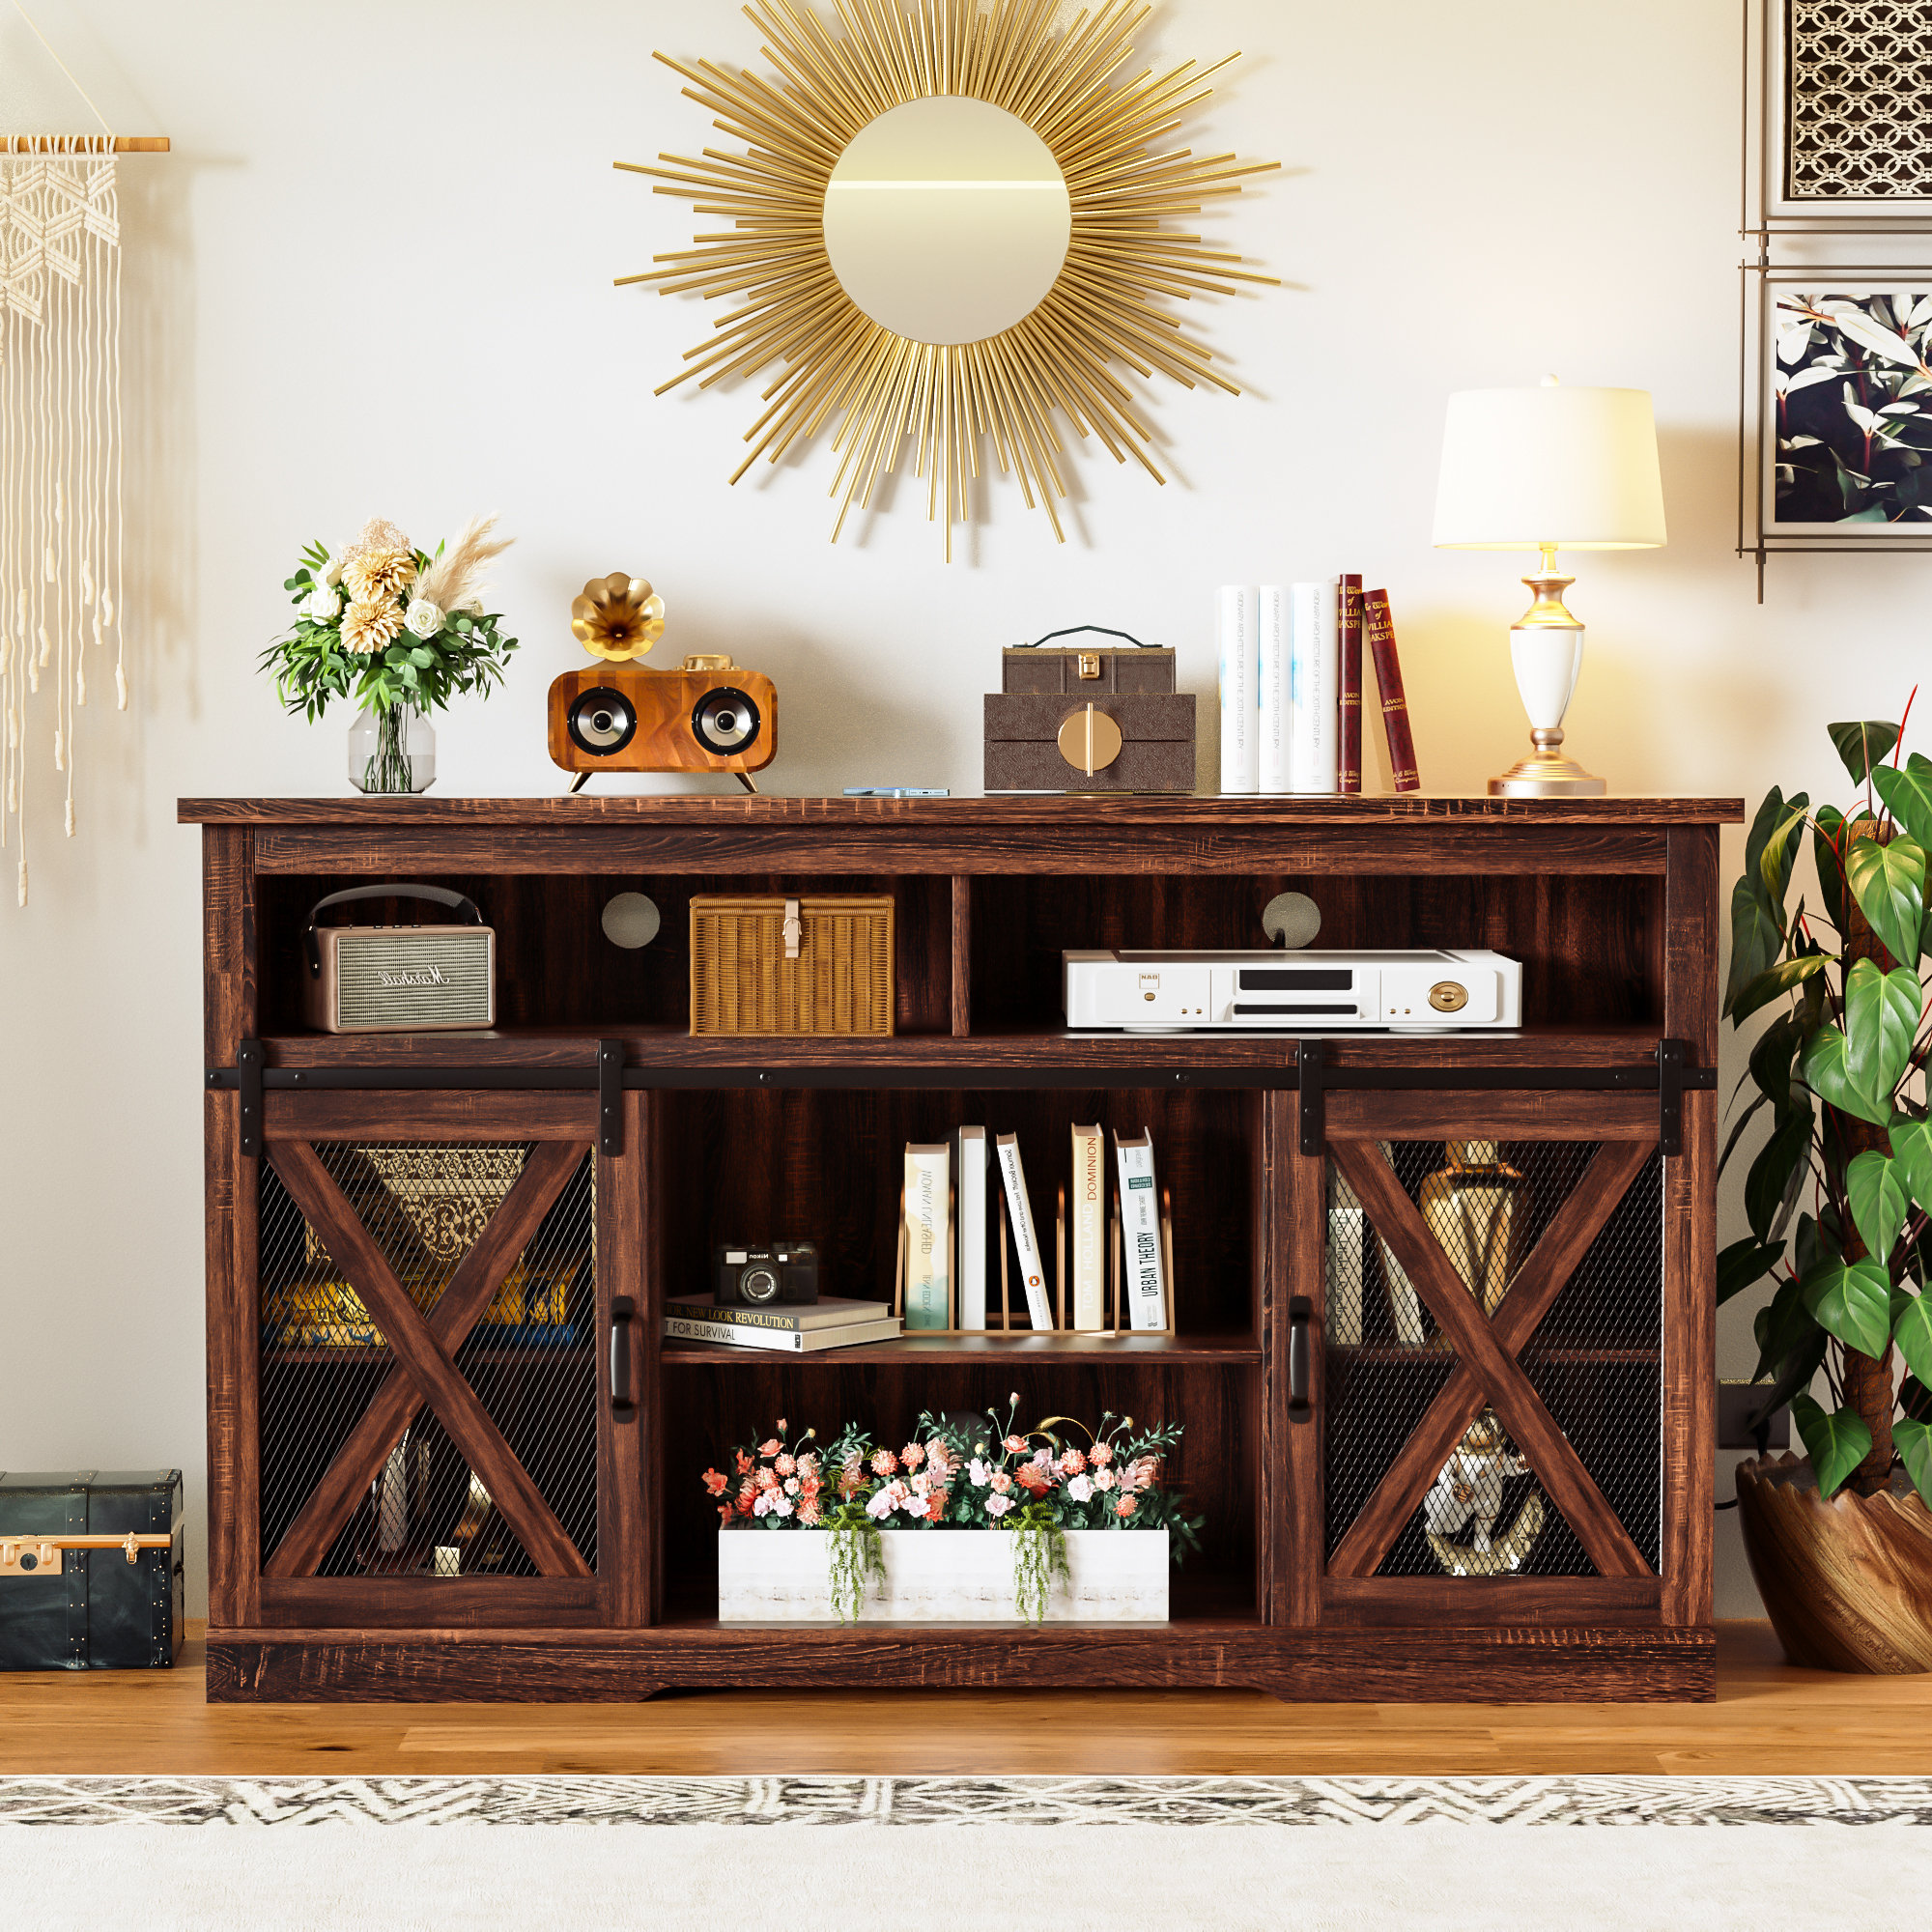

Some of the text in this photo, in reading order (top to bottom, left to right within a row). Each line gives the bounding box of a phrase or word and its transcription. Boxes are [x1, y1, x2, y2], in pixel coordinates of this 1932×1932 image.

[1087, 1137, 1097, 1201] DOMINION
[1082, 1204, 1094, 1311] TOM HOLLAND
[1137, 1232, 1156, 1264] THEORY
[1140, 1266, 1158, 1297] URBAN
[672, 1321, 692, 1335] FOR
[695, 1323, 735, 1341] SURVIVAL
[686, 1306, 706, 1319] NEW
[708, 1307, 734, 1322] LOOK
[735, 1312, 794, 1329] REVOLUTION
